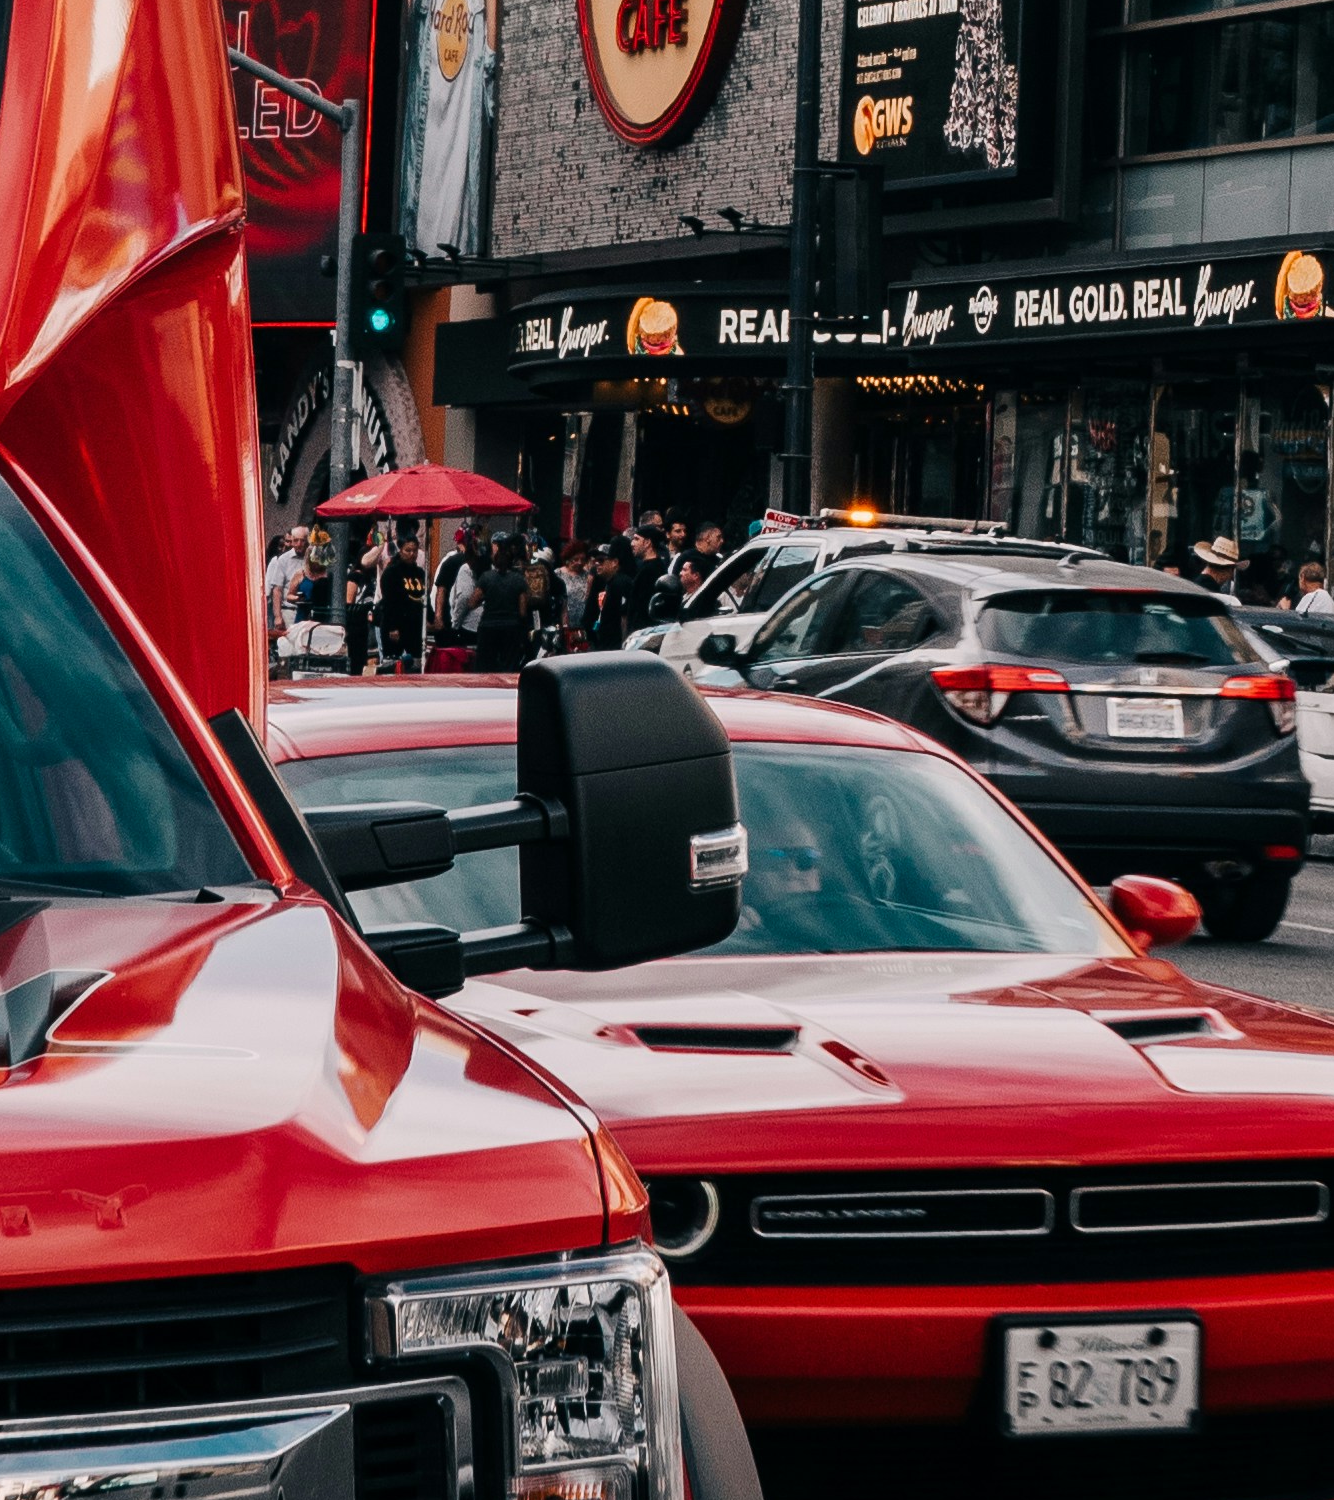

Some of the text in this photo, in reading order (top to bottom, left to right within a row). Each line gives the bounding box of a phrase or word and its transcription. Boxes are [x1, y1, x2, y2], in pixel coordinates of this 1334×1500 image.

[857, 1, 894, 29] CELEBRITY
[873, 95, 913, 138] GWS
[901, 290, 954, 347] Burger.
[1014, 286, 1065, 327] REAL
[1069, 283, 1128, 323] GOLD.
[1133, 277, 1187, 319] REAL
[1193, 263, 1257, 327] Burger.
[526, 317, 554, 351] REAL
[558, 306, 610, 359] Burger.
[1048, 1356, 1181, 1409] 82 789
